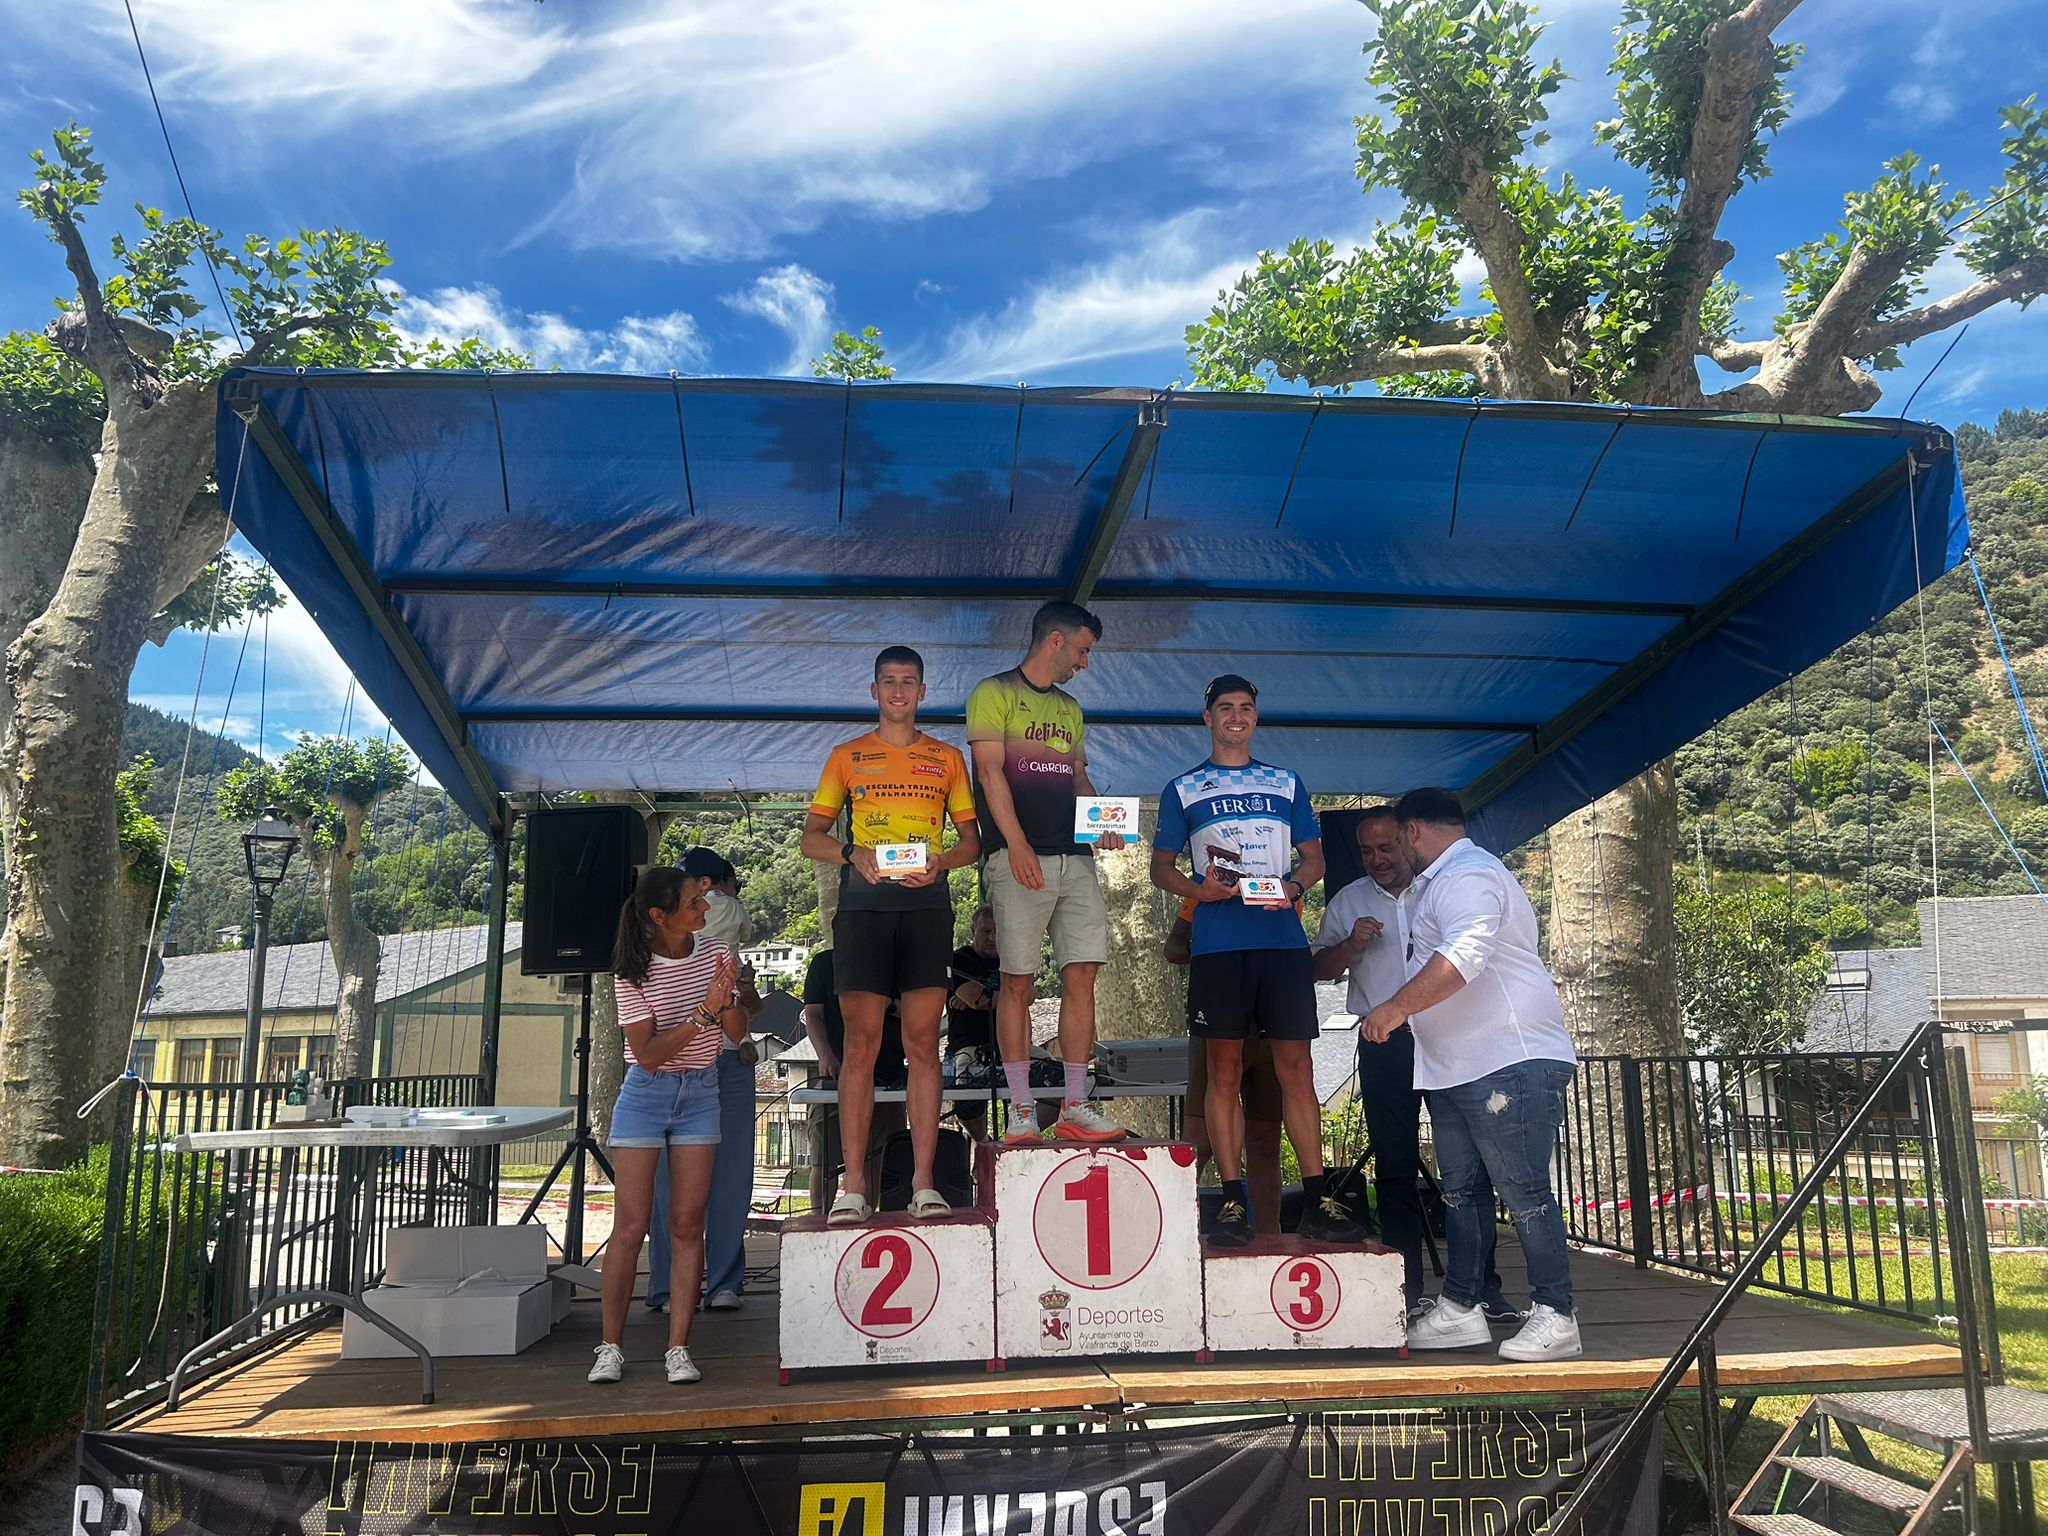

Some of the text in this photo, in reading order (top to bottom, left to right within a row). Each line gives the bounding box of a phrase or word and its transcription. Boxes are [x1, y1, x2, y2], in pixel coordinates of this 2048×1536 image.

[875, 792, 935, 800] SALMANTINA
[1064, 1165, 1111, 1276] 1
[861, 1235, 912, 1325] 2
[1289, 1262, 1324, 1325] 3
[1078, 1306, 1164, 1327] Deportes
[1079, 1331, 1129, 1340] Ayuntamiento
